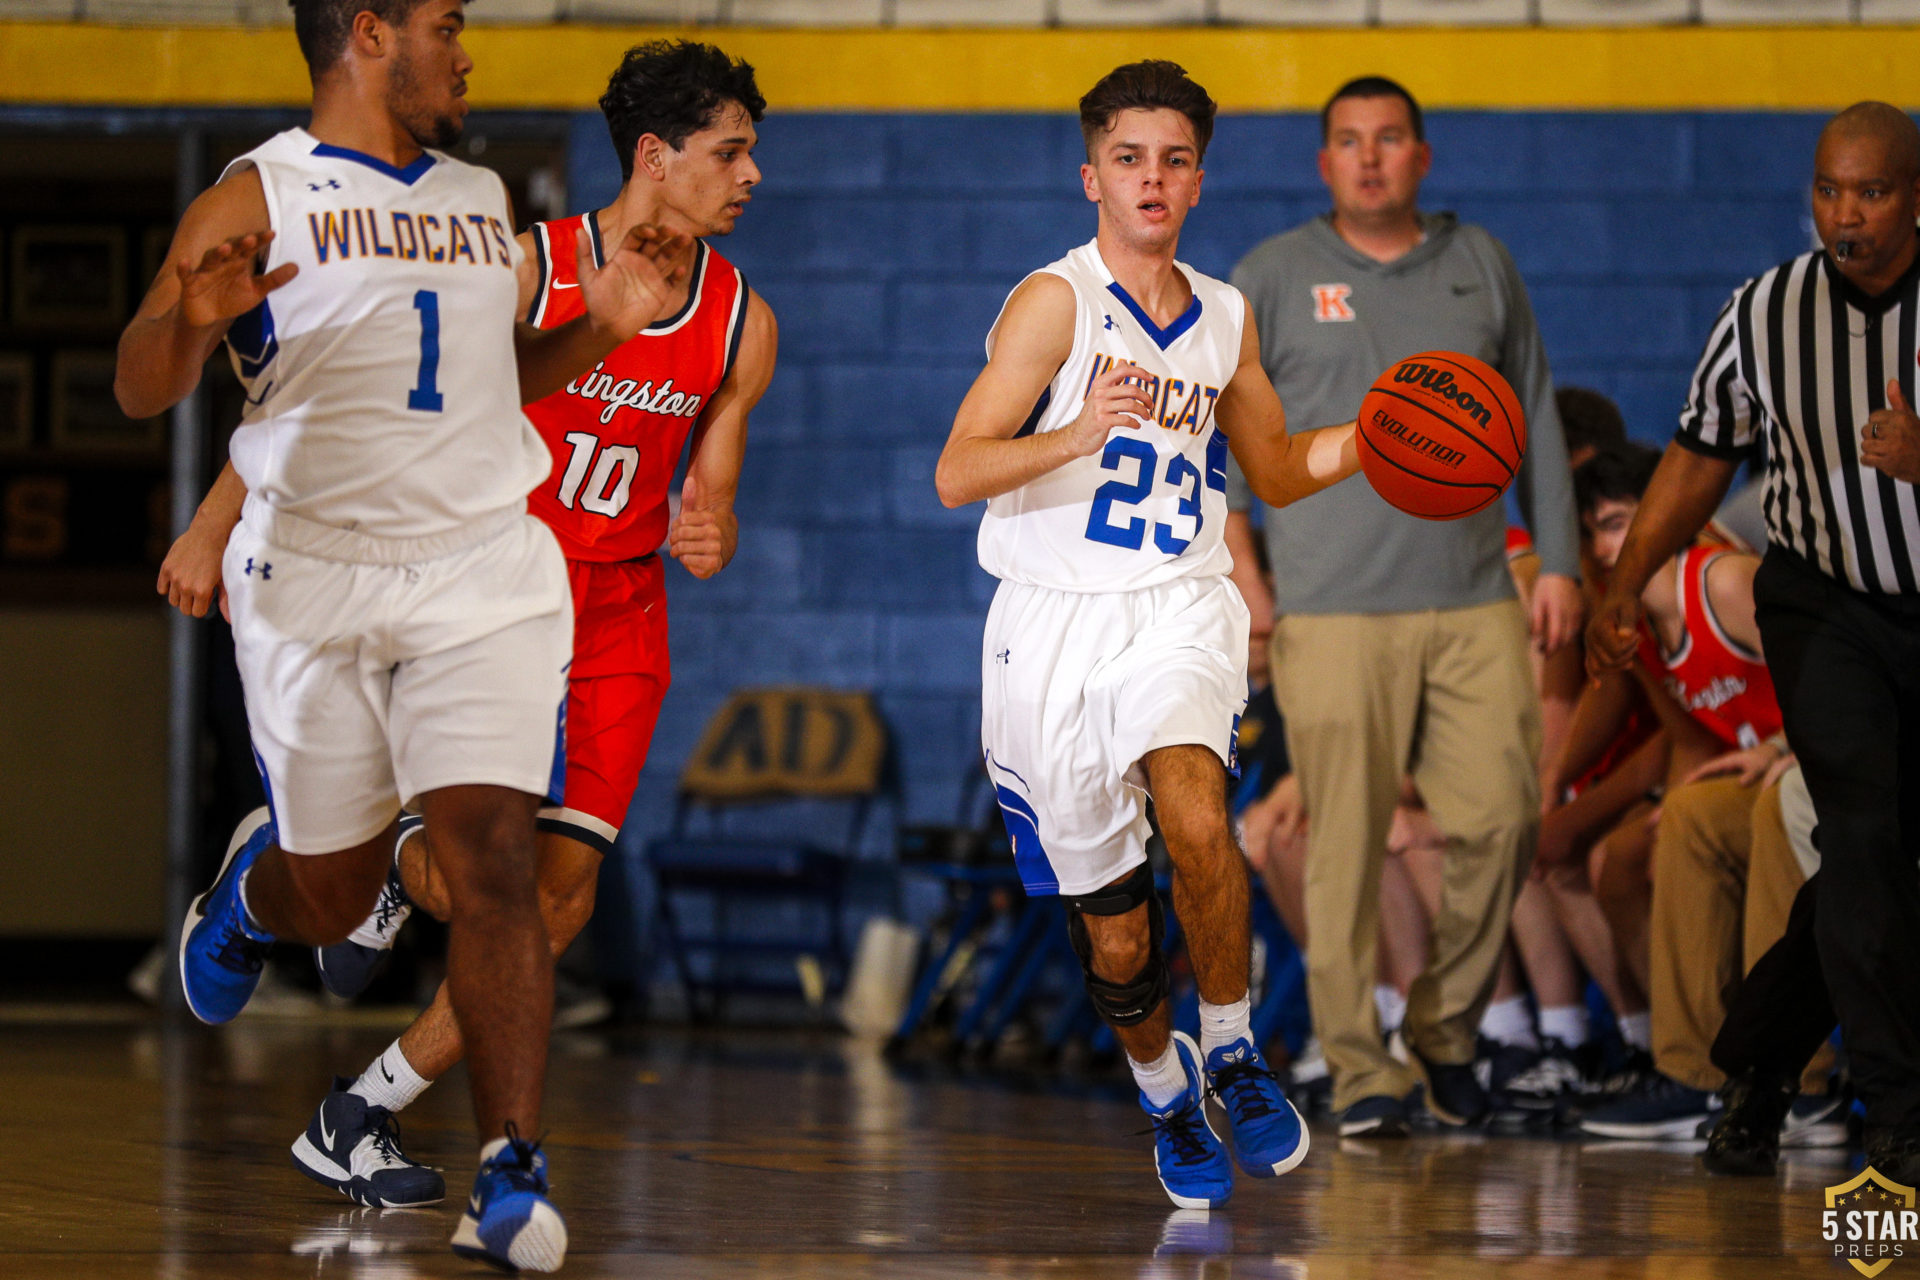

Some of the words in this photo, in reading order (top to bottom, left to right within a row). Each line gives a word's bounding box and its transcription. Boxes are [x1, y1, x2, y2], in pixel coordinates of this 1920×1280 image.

[308, 208, 512, 269] WILDCATS
[1311, 283, 1356, 322] K
[407, 289, 443, 413] 1
[566, 361, 701, 424] ingston
[1394, 363, 1492, 431] Wilson
[1372, 409, 1466, 466] EVOLUTION
[556, 430, 640, 519] 10
[1085, 435, 1203, 557] 23
